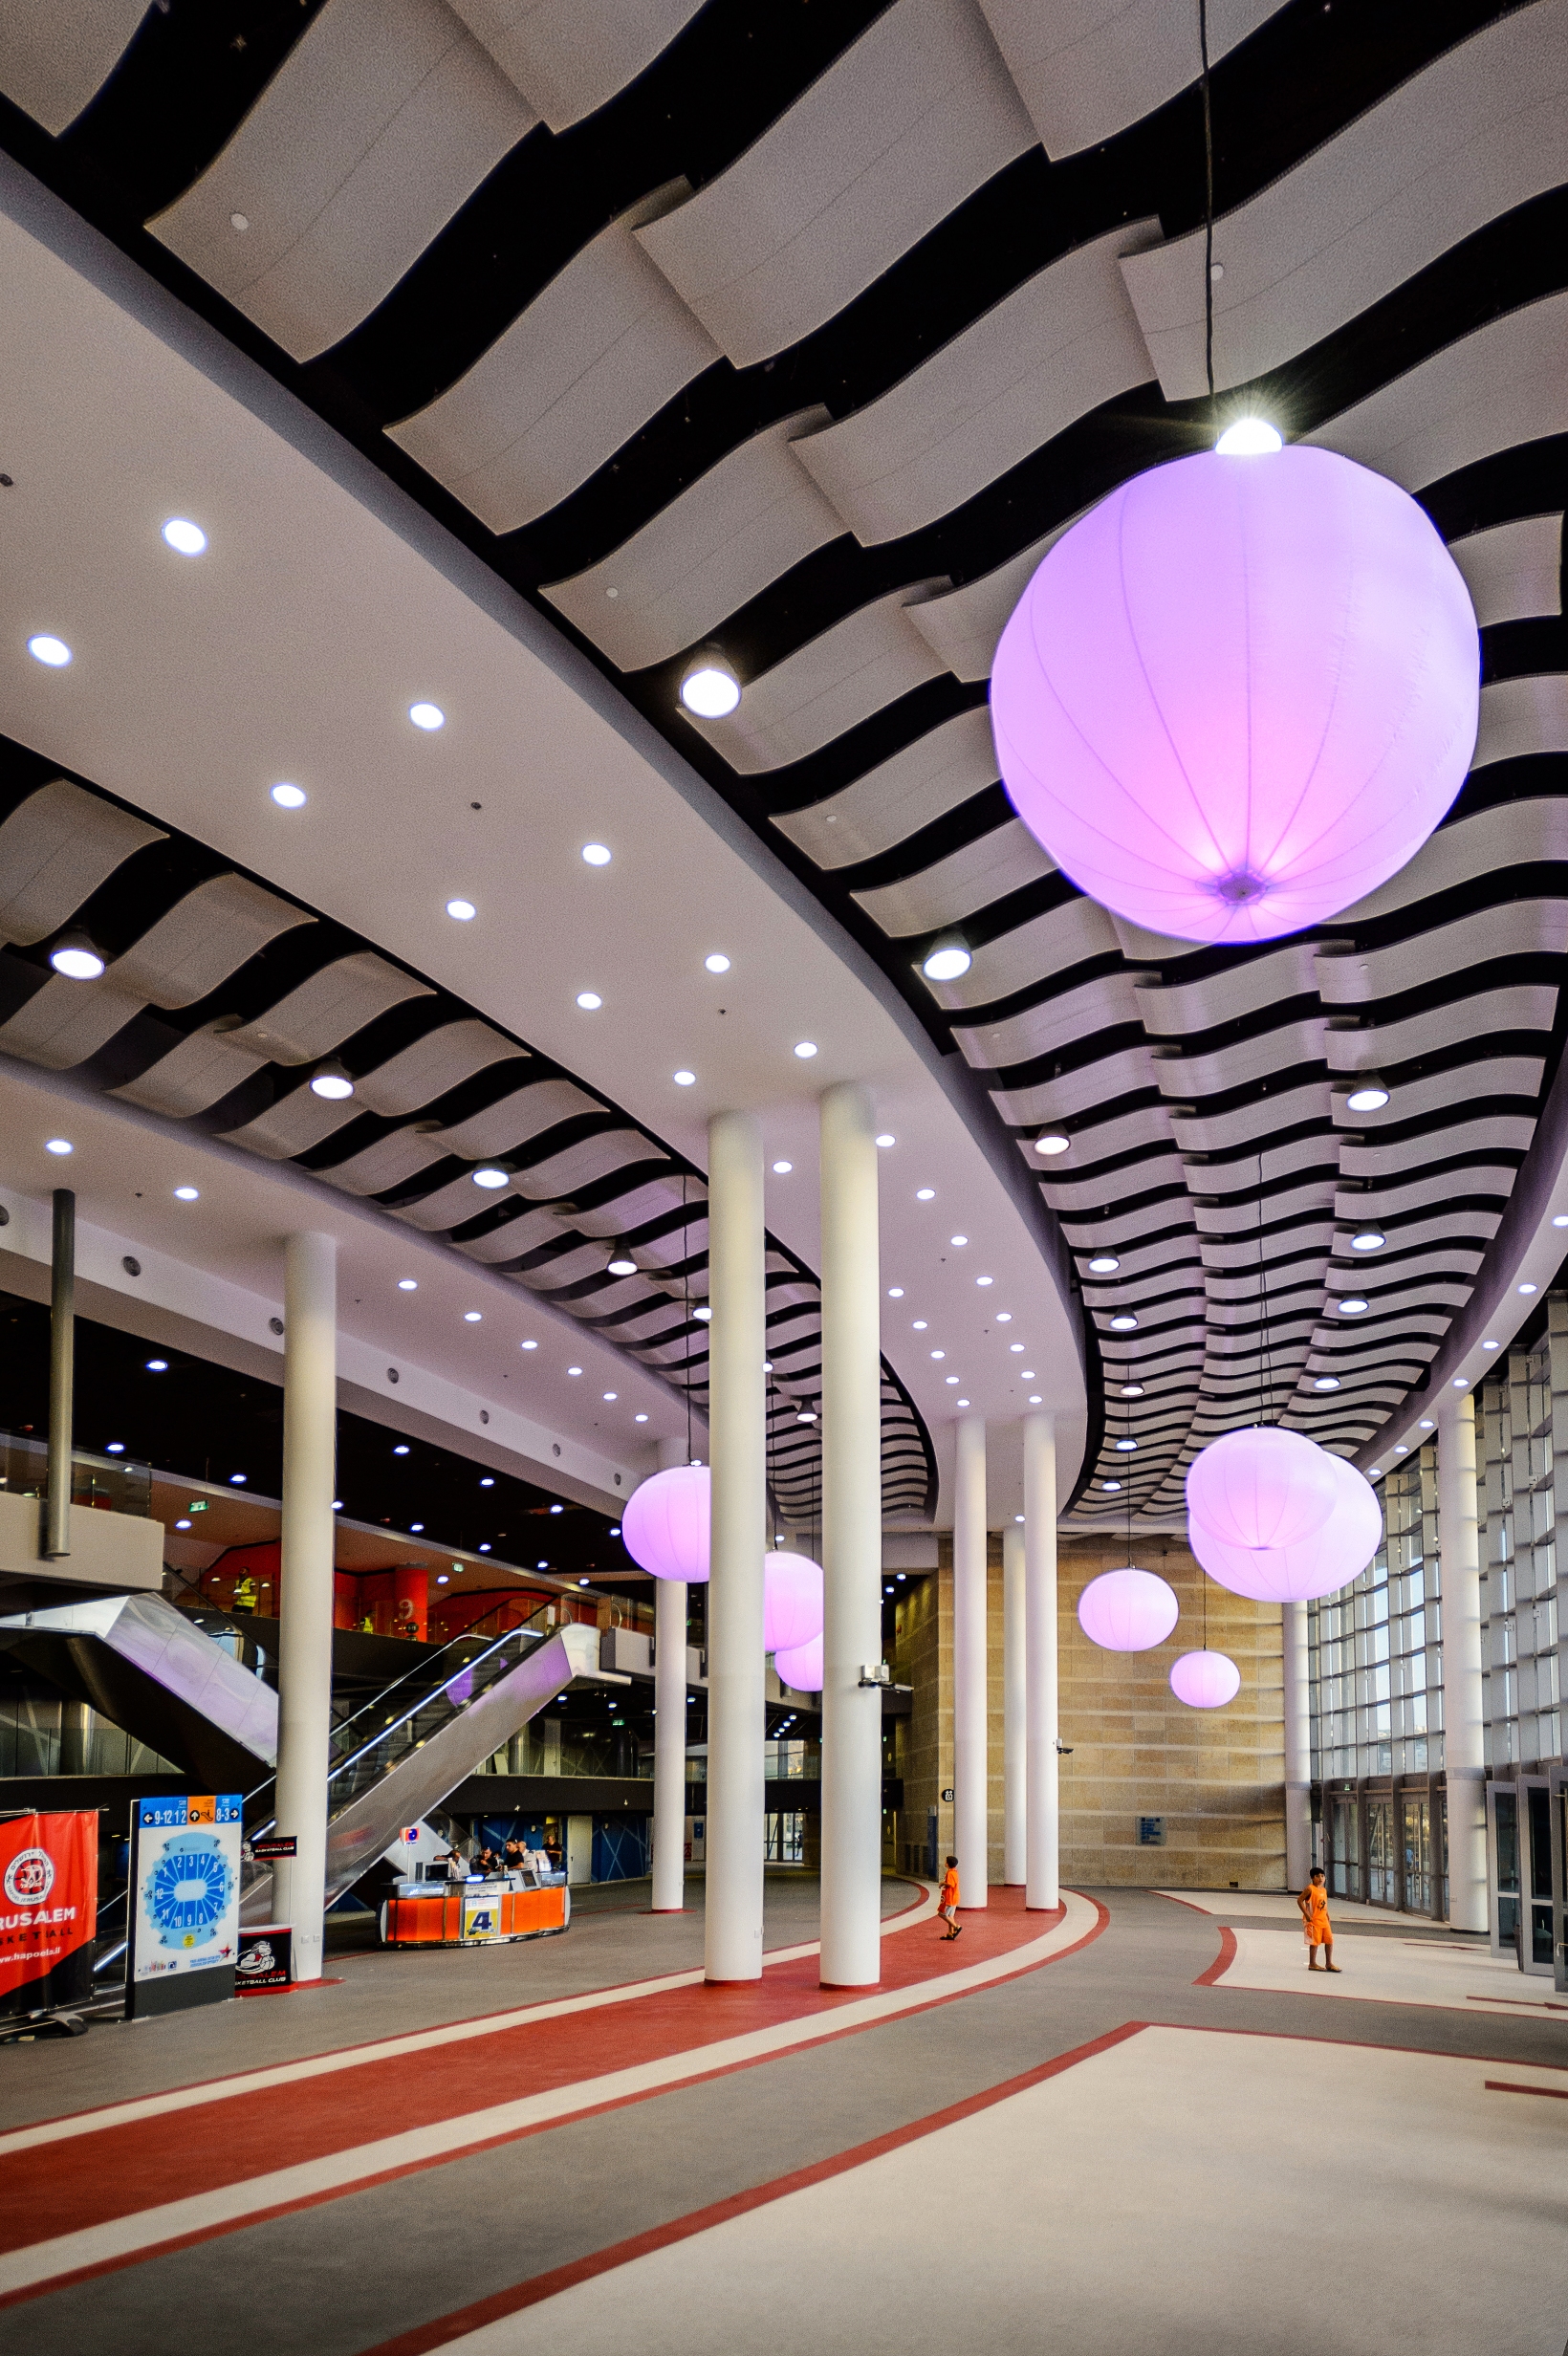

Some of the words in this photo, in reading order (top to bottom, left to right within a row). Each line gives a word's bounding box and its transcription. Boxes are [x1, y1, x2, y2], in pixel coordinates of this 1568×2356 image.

[216, 1807, 230, 1822] 8-3
[177, 1856, 183, 1868] 2
[188, 1855, 195, 1867] 3
[200, 1854, 207, 1865] 4
[156, 1887, 164, 1900] 12
[218, 1881, 225, 1893] 6
[173, 1915, 183, 1928] 10
[186, 1914, 192, 1927] 9
[198, 1912, 204, 1925] 8
[471, 1910, 493, 1931] 4
